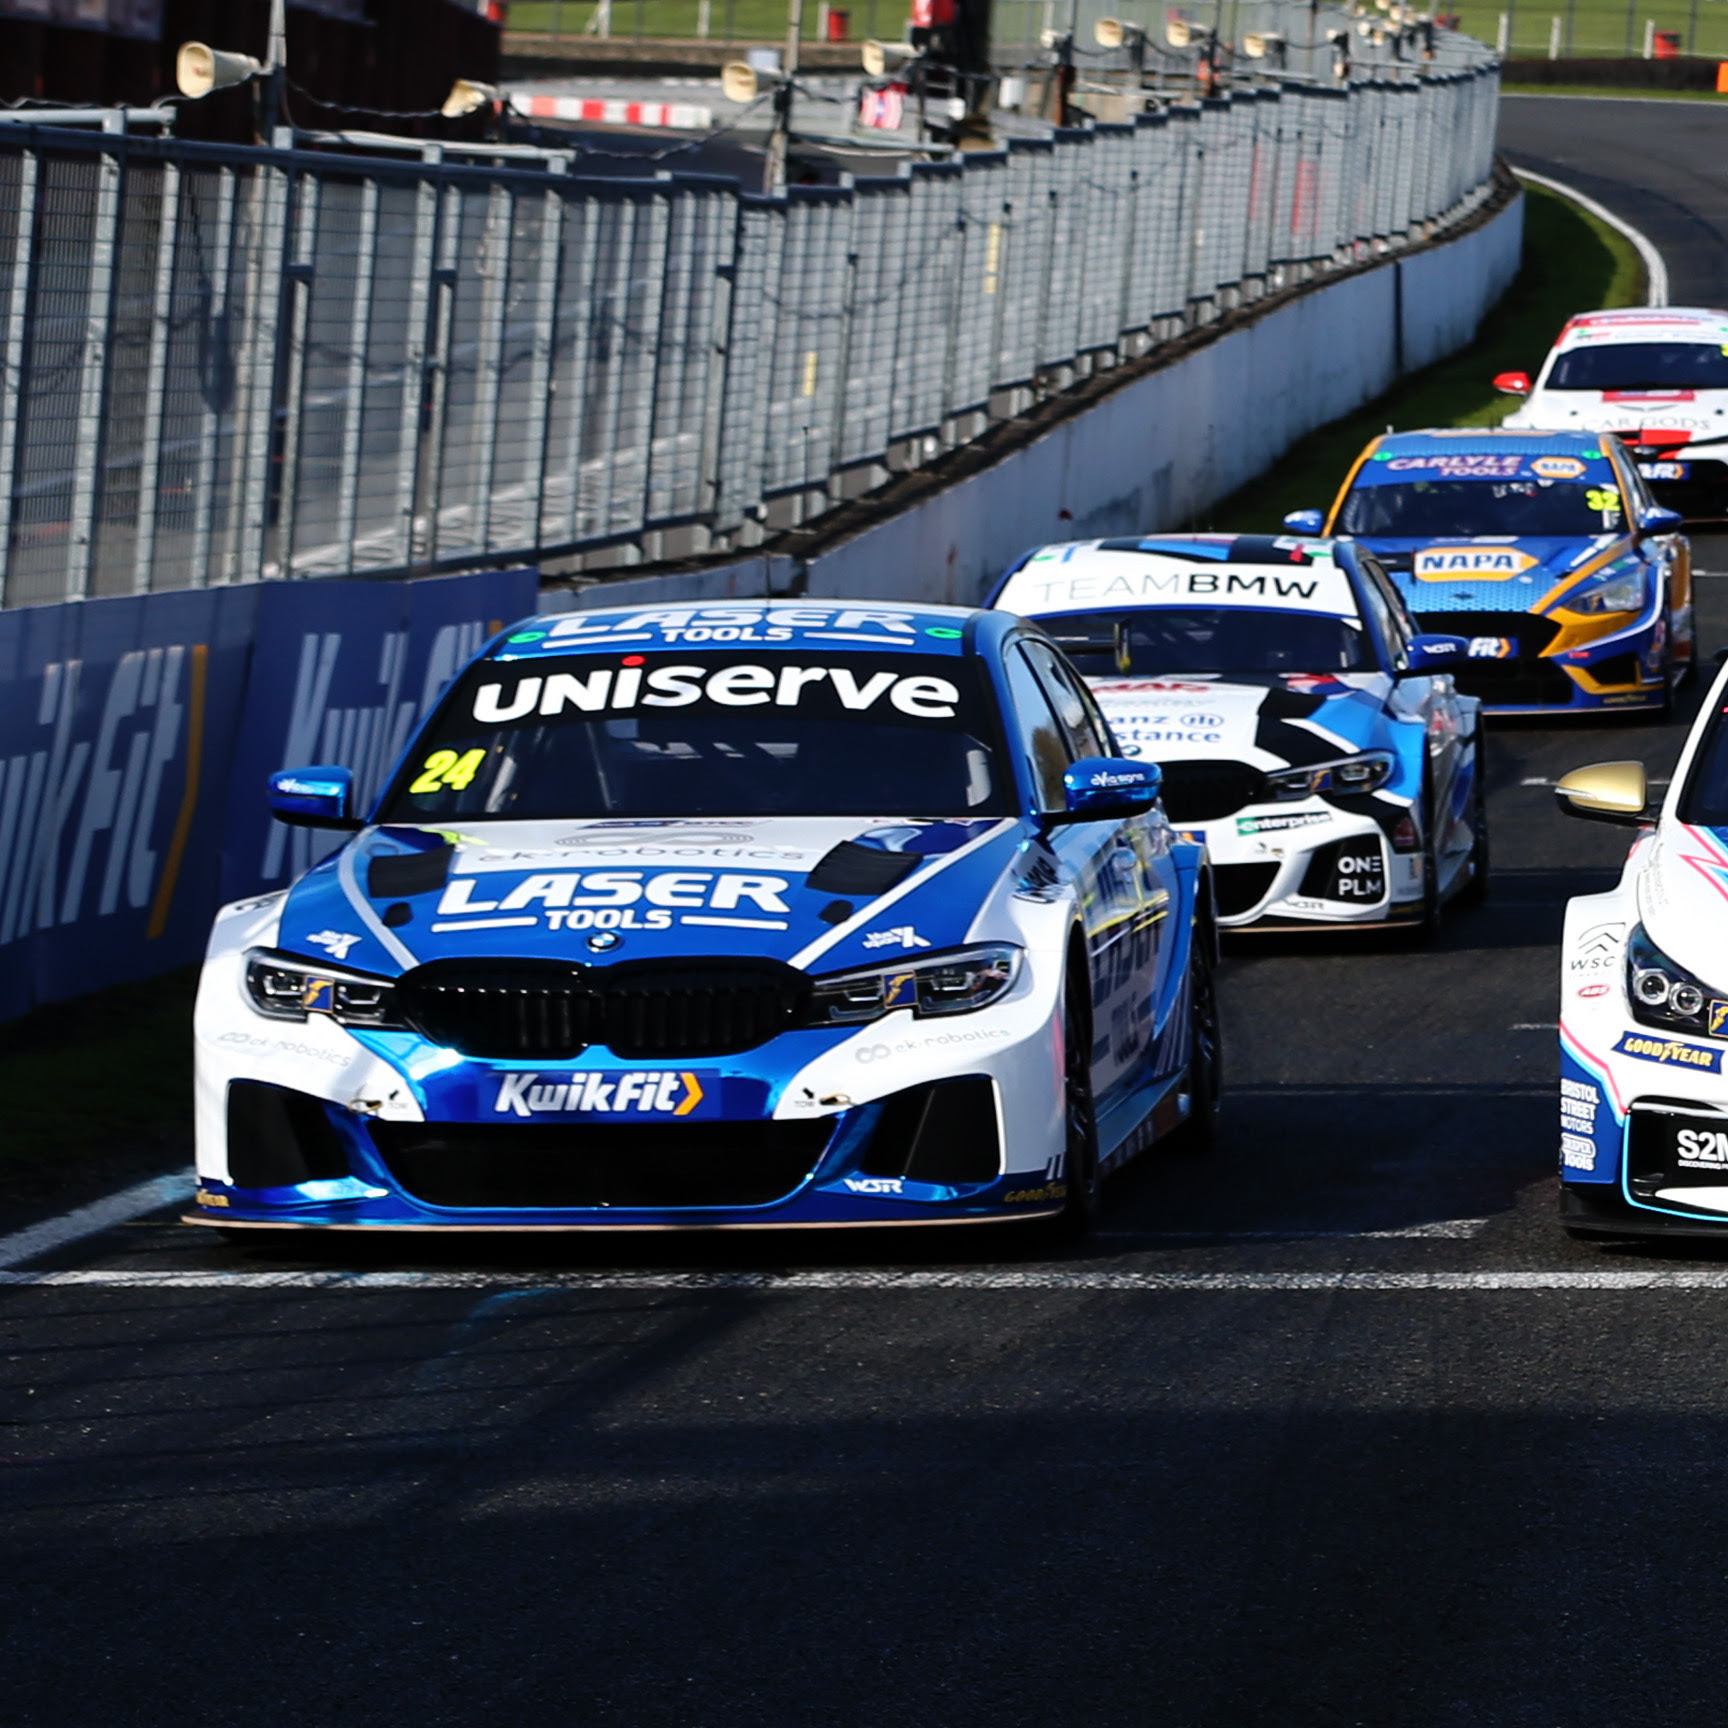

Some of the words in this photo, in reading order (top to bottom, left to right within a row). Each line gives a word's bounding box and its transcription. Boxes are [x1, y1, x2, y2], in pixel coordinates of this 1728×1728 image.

[1386, 455, 1523, 471] CARLYLE
[1585, 489, 1621, 512] 32
[1421, 554, 1515, 571] NAPA
[548, 608, 917, 637] LASER
[660, 627, 793, 644] TOOLS
[408, 748, 488, 794] 24
[1337, 856, 1382, 874] ONE
[437, 872, 791, 916] LASER
[1337, 877, 1382, 897] PLM
[544, 908, 674, 931] TOOLS
[1570, 955, 1617, 971] WSC
[1560, 1097, 1598, 1121] STREET
[843, 1176, 905, 1196] WSR
